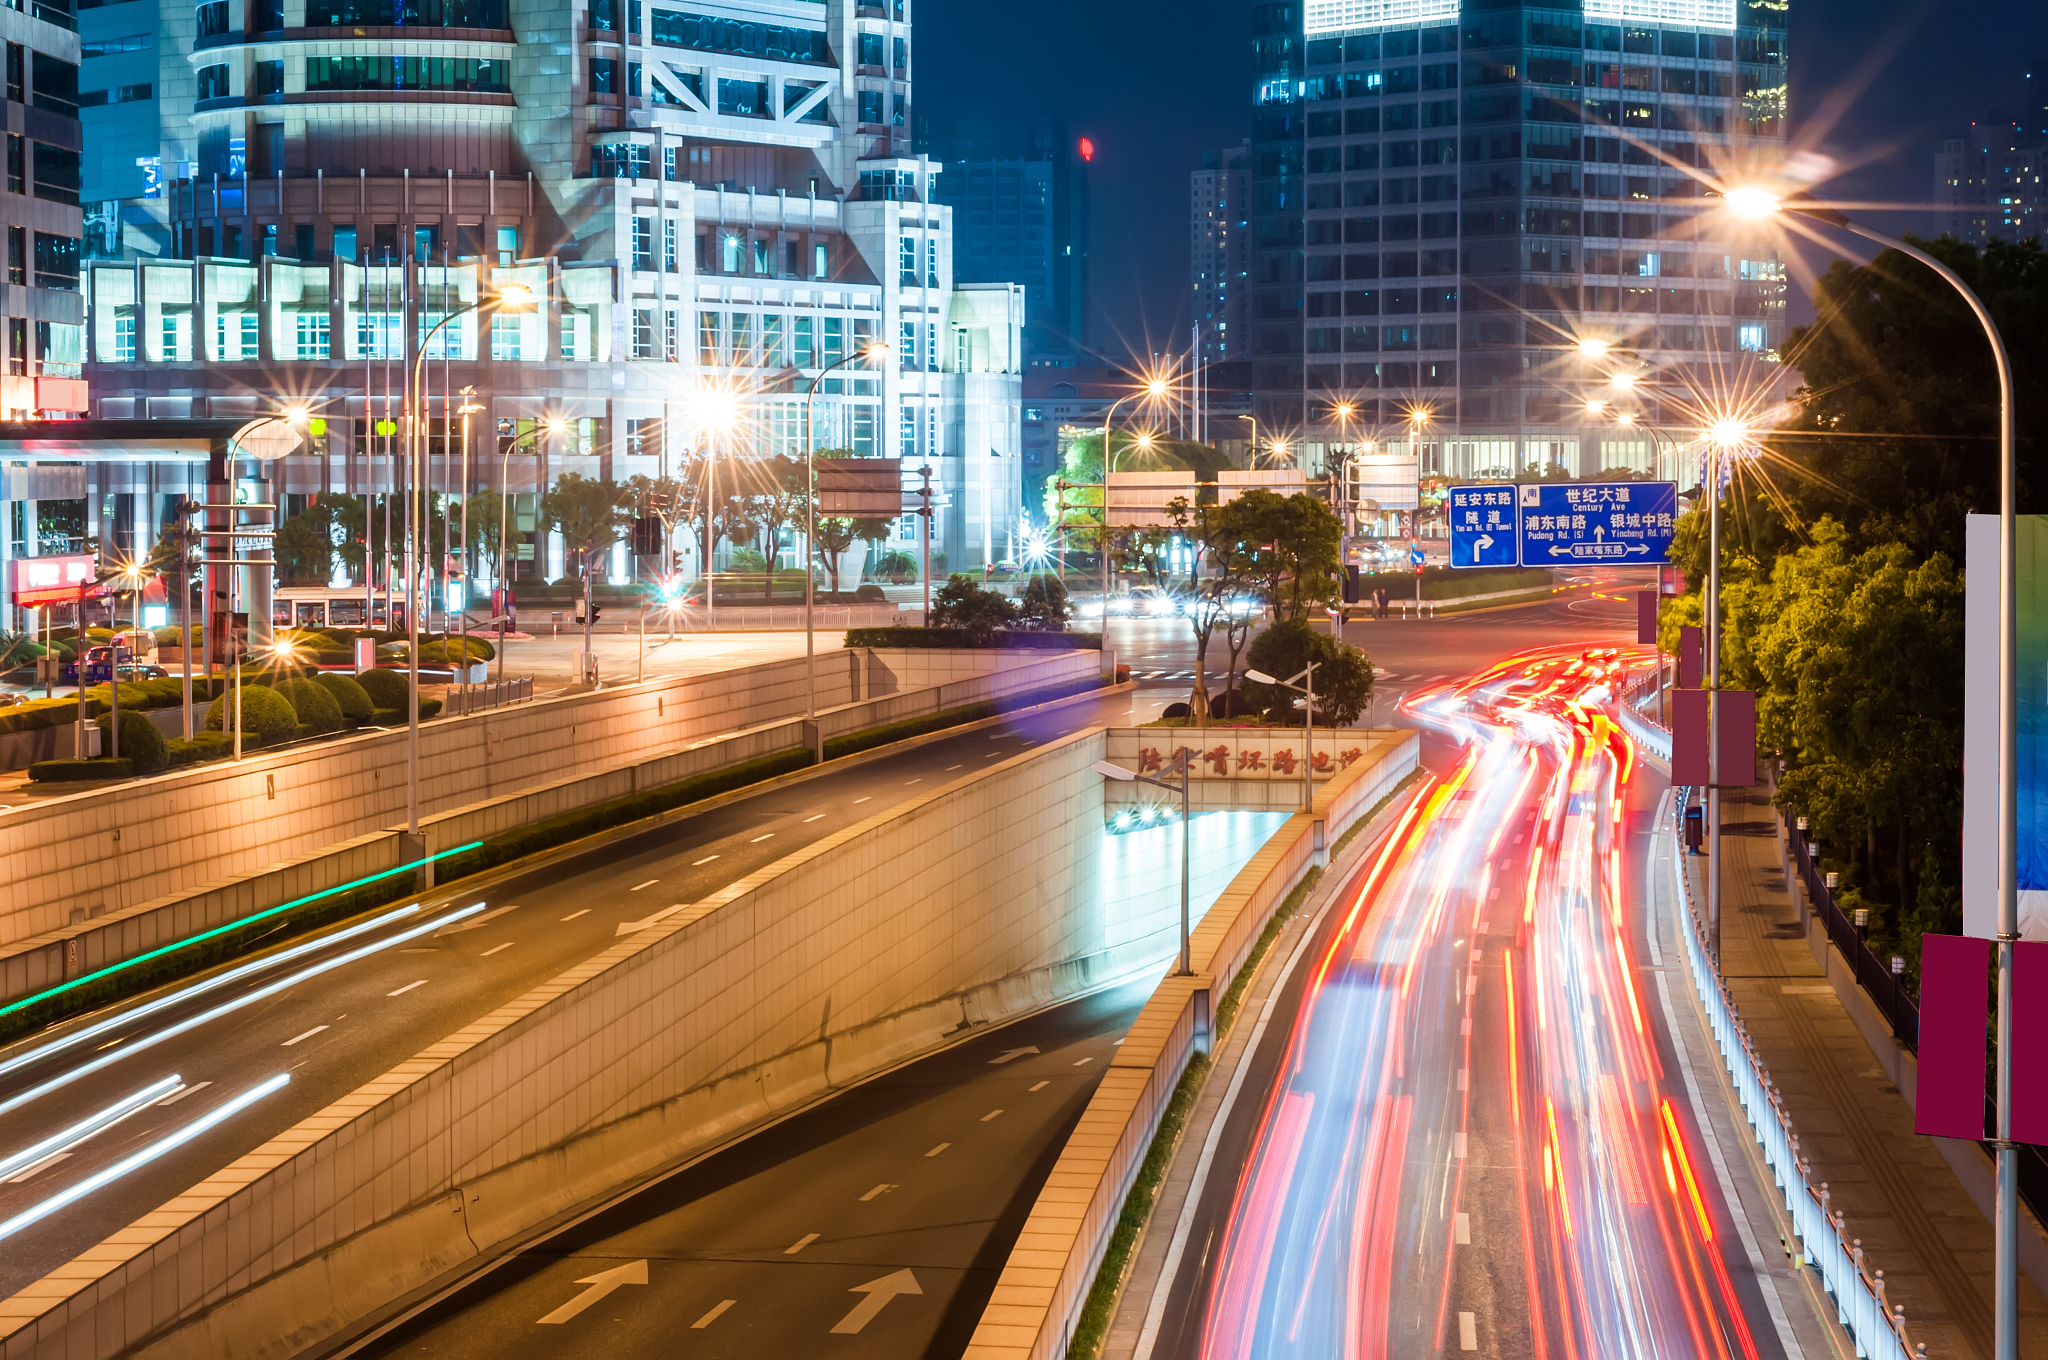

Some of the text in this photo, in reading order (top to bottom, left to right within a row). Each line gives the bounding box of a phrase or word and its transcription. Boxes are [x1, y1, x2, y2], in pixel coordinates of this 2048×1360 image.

[1527, 488, 1538, 498] 南
[1566, 487, 1630, 503] 世纪大道
[1454, 492, 1511, 507] 延安东路
[1572, 503, 1626, 513] Century Ave
[1465, 510, 1501, 524] 隧道
[1525, 514, 1587, 530] 浦东南路
[1610, 512, 1672, 528] 银城中路
[1495, 523, 1512, 531] Tunnel
[1528, 530, 1584, 541] Pudong Rd. (S)
[1611, 528, 1672, 539] Yincheng Rd. (M)
[1574, 545, 1623, 556] 陆家嘴东路
